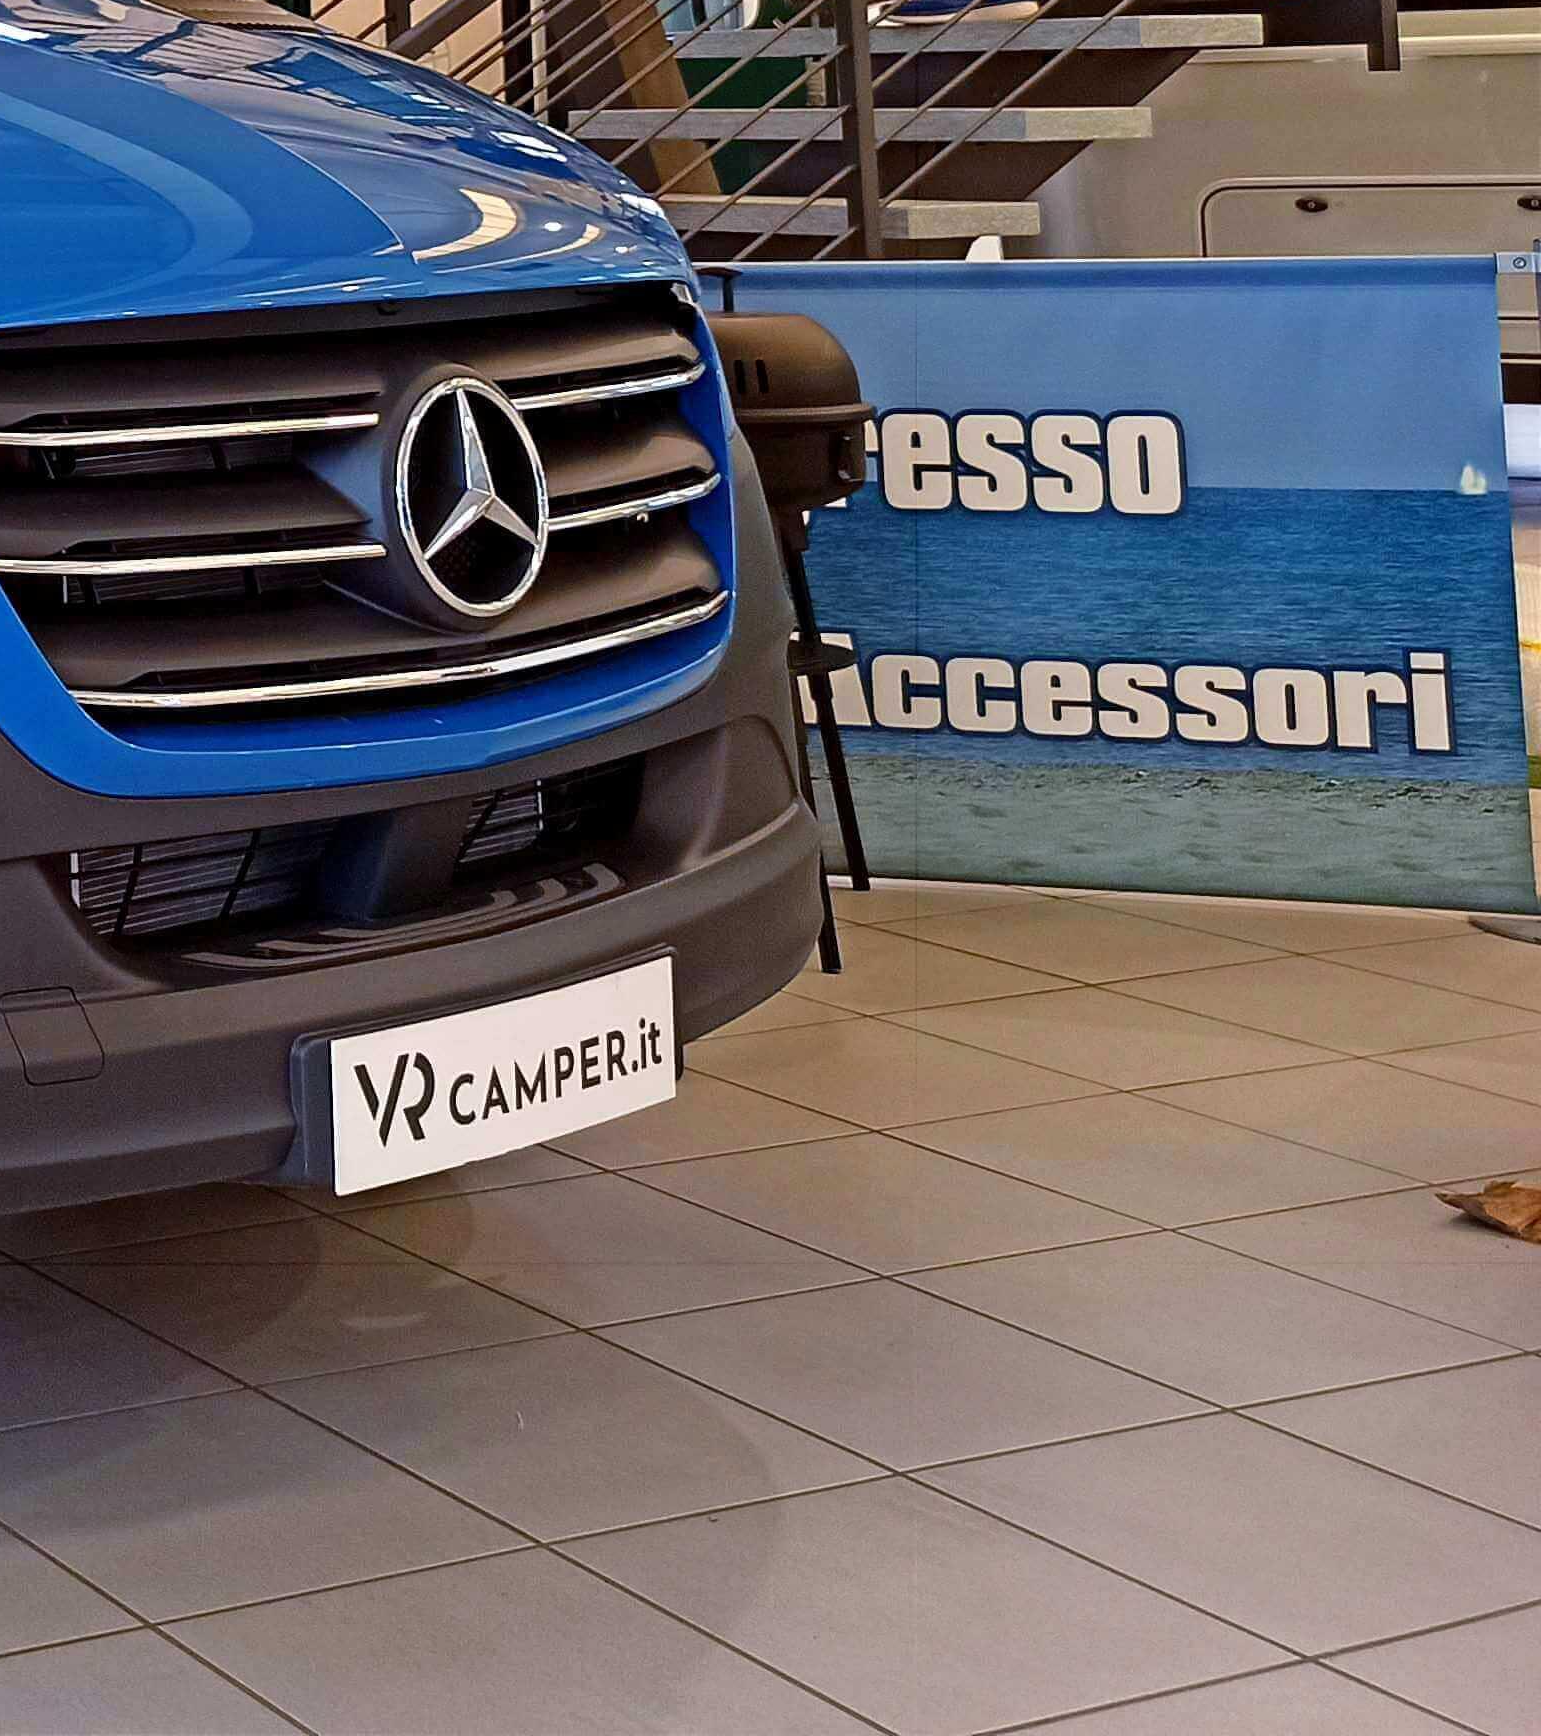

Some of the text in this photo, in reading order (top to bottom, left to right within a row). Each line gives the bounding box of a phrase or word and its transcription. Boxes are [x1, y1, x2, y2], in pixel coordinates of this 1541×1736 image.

[864, 413, 1182, 515] esso
[353, 1016, 663, 1148] VR CAMPER.it
